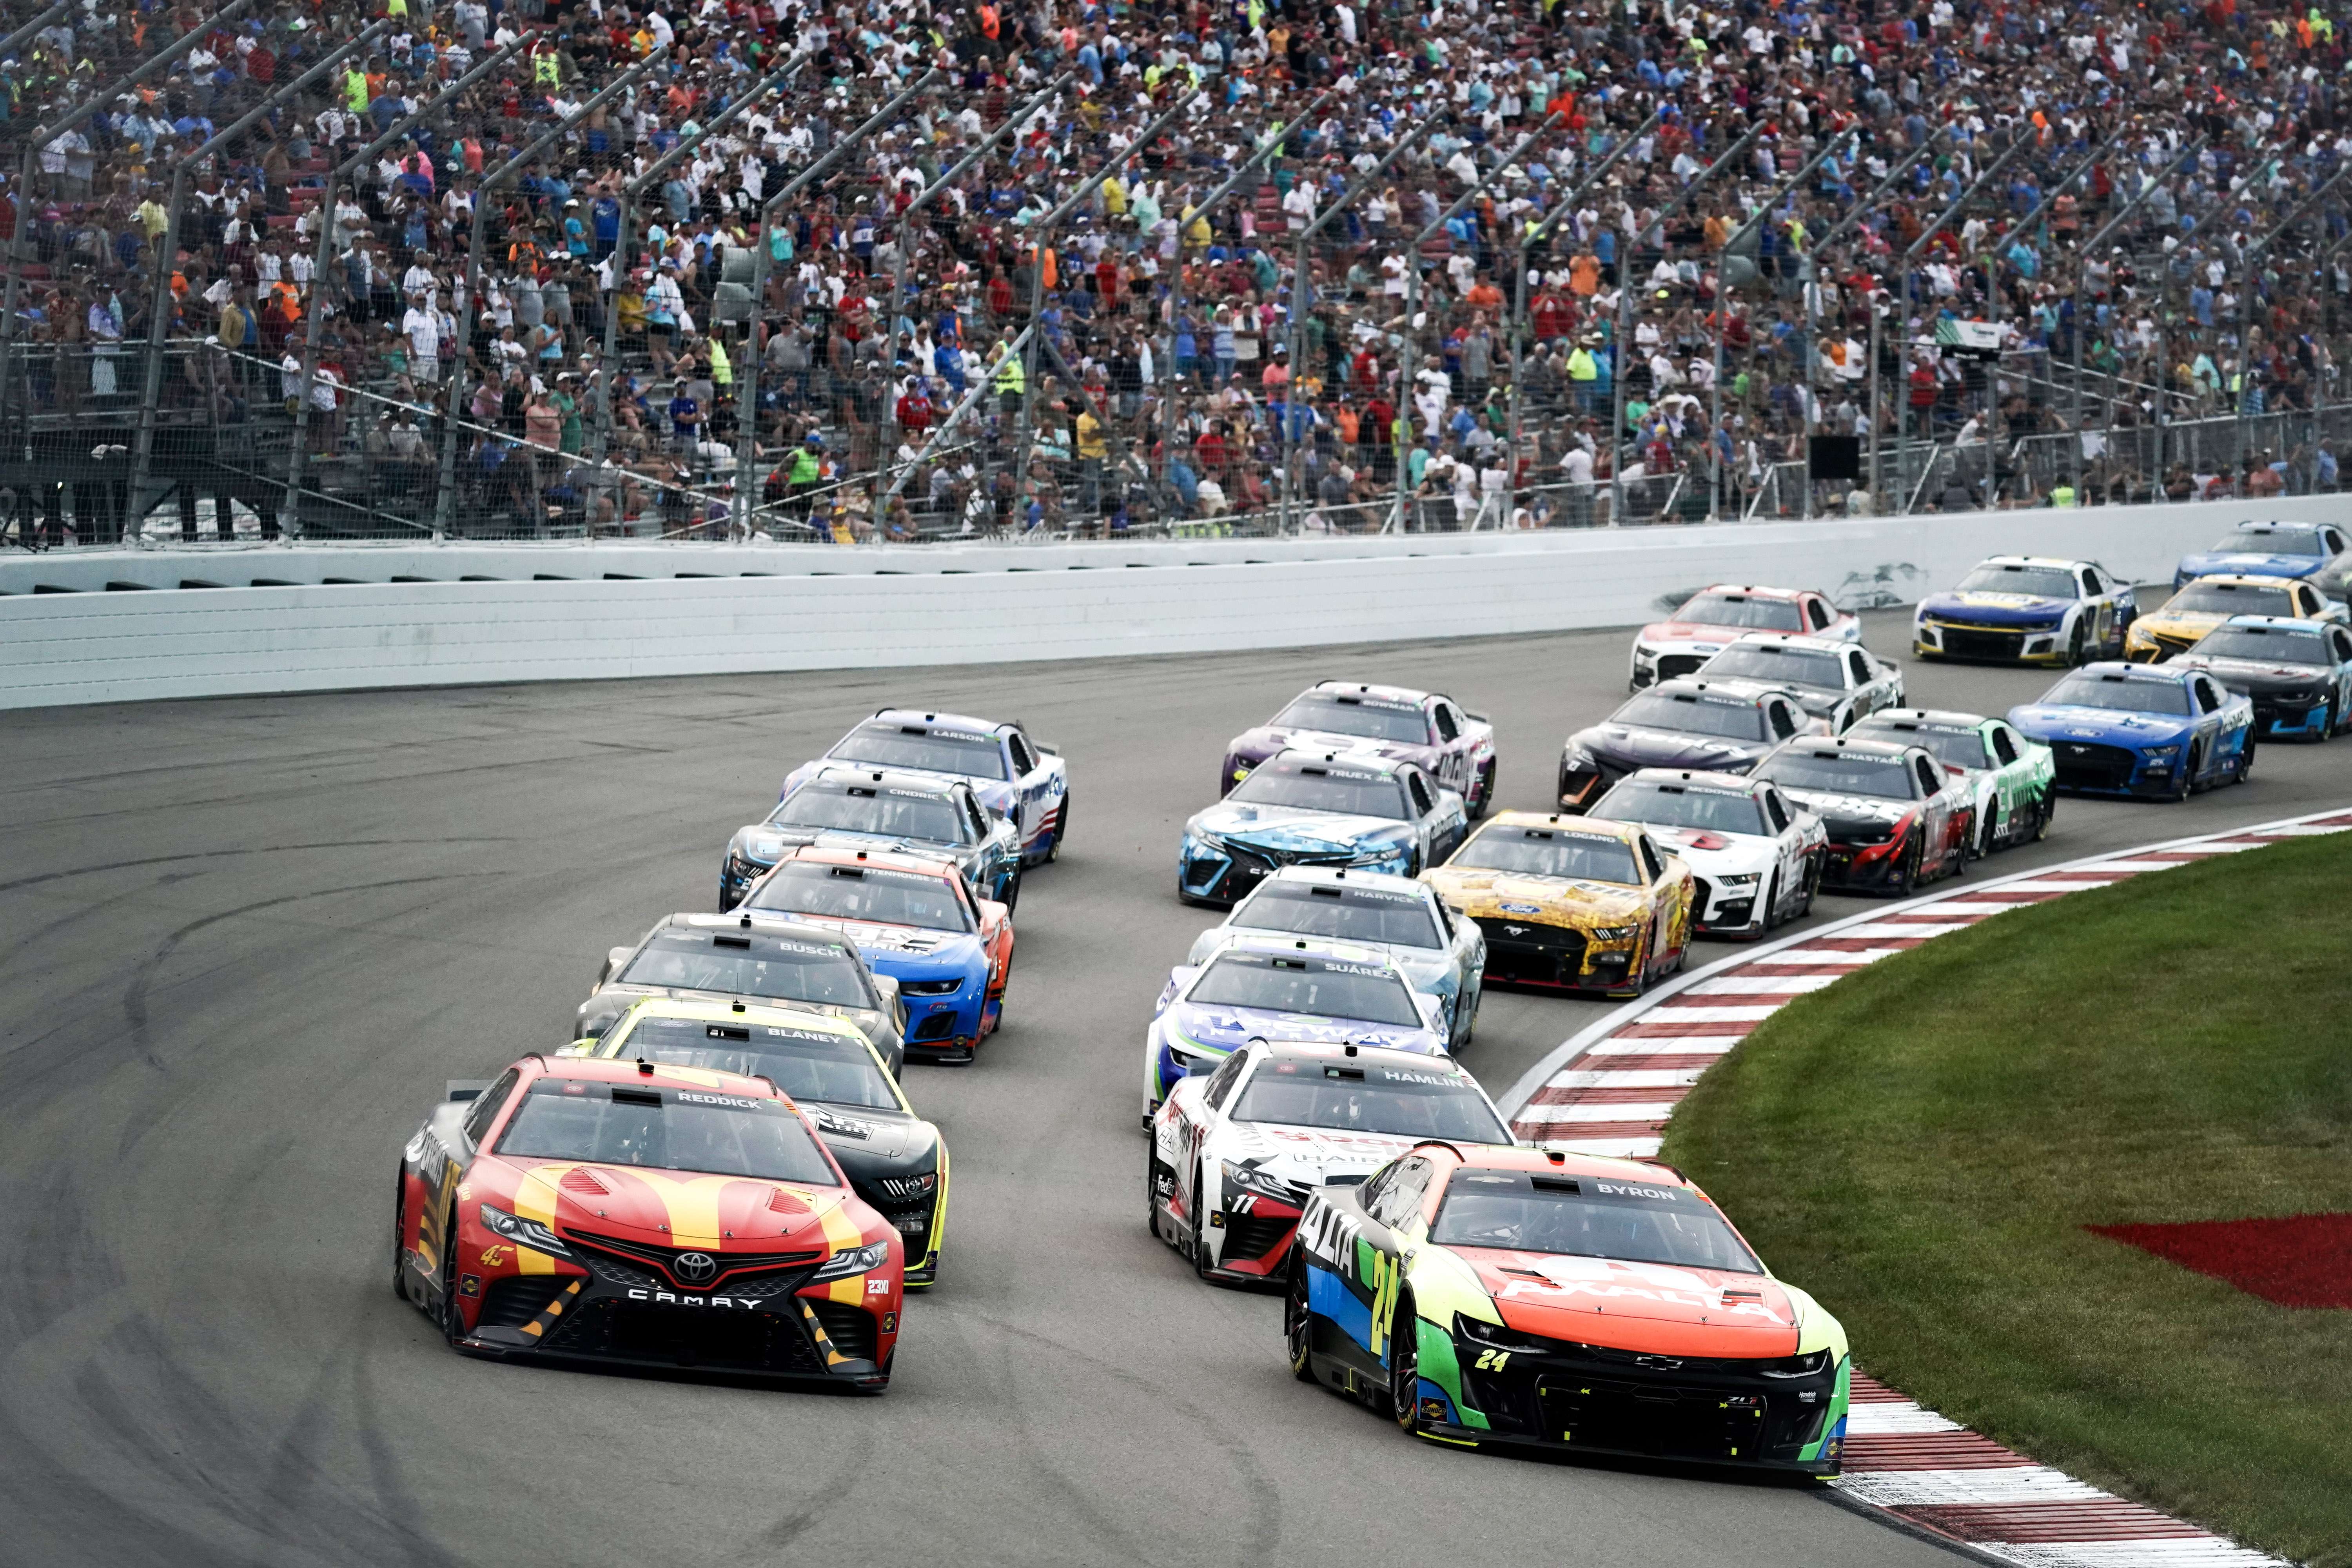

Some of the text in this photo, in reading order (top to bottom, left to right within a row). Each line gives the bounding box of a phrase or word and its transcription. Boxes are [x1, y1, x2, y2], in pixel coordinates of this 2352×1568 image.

[933, 730, 984, 742] LARSON
[1328, 769, 1372, 780] TRUEX
[889, 788, 939, 800] CINDRIC
[1564, 831, 1617, 843] LOGANO
[863, 867, 930, 882] STENHOUSE
[1354, 891, 1415, 904] HARVICK
[780, 942, 842, 958] BUSCH
[768, 1027, 841, 1044] BLANEY
[1385, 1071, 1465, 1088] HAMLIN
[678, 1092, 762, 1110] REDDICK
[1158, 1174, 1175, 1196] FedEx
[1597, 1183, 1677, 1201] BYRON
[1231, 1194, 1259, 1214] 11
[479, 1244, 515, 1267] 45
[868, 1279, 889, 1294] 23XI
[628, 1289, 763, 1310] CAMRY
[1370, 1249, 1399, 1356] 24
[1504, 1279, 1789, 1325] AXALTA
[1474, 1349, 1512, 1372] 24
[1726, 1396, 1758, 1405] ZL1
[1421, 1405, 1446, 1416] SUNOCO
